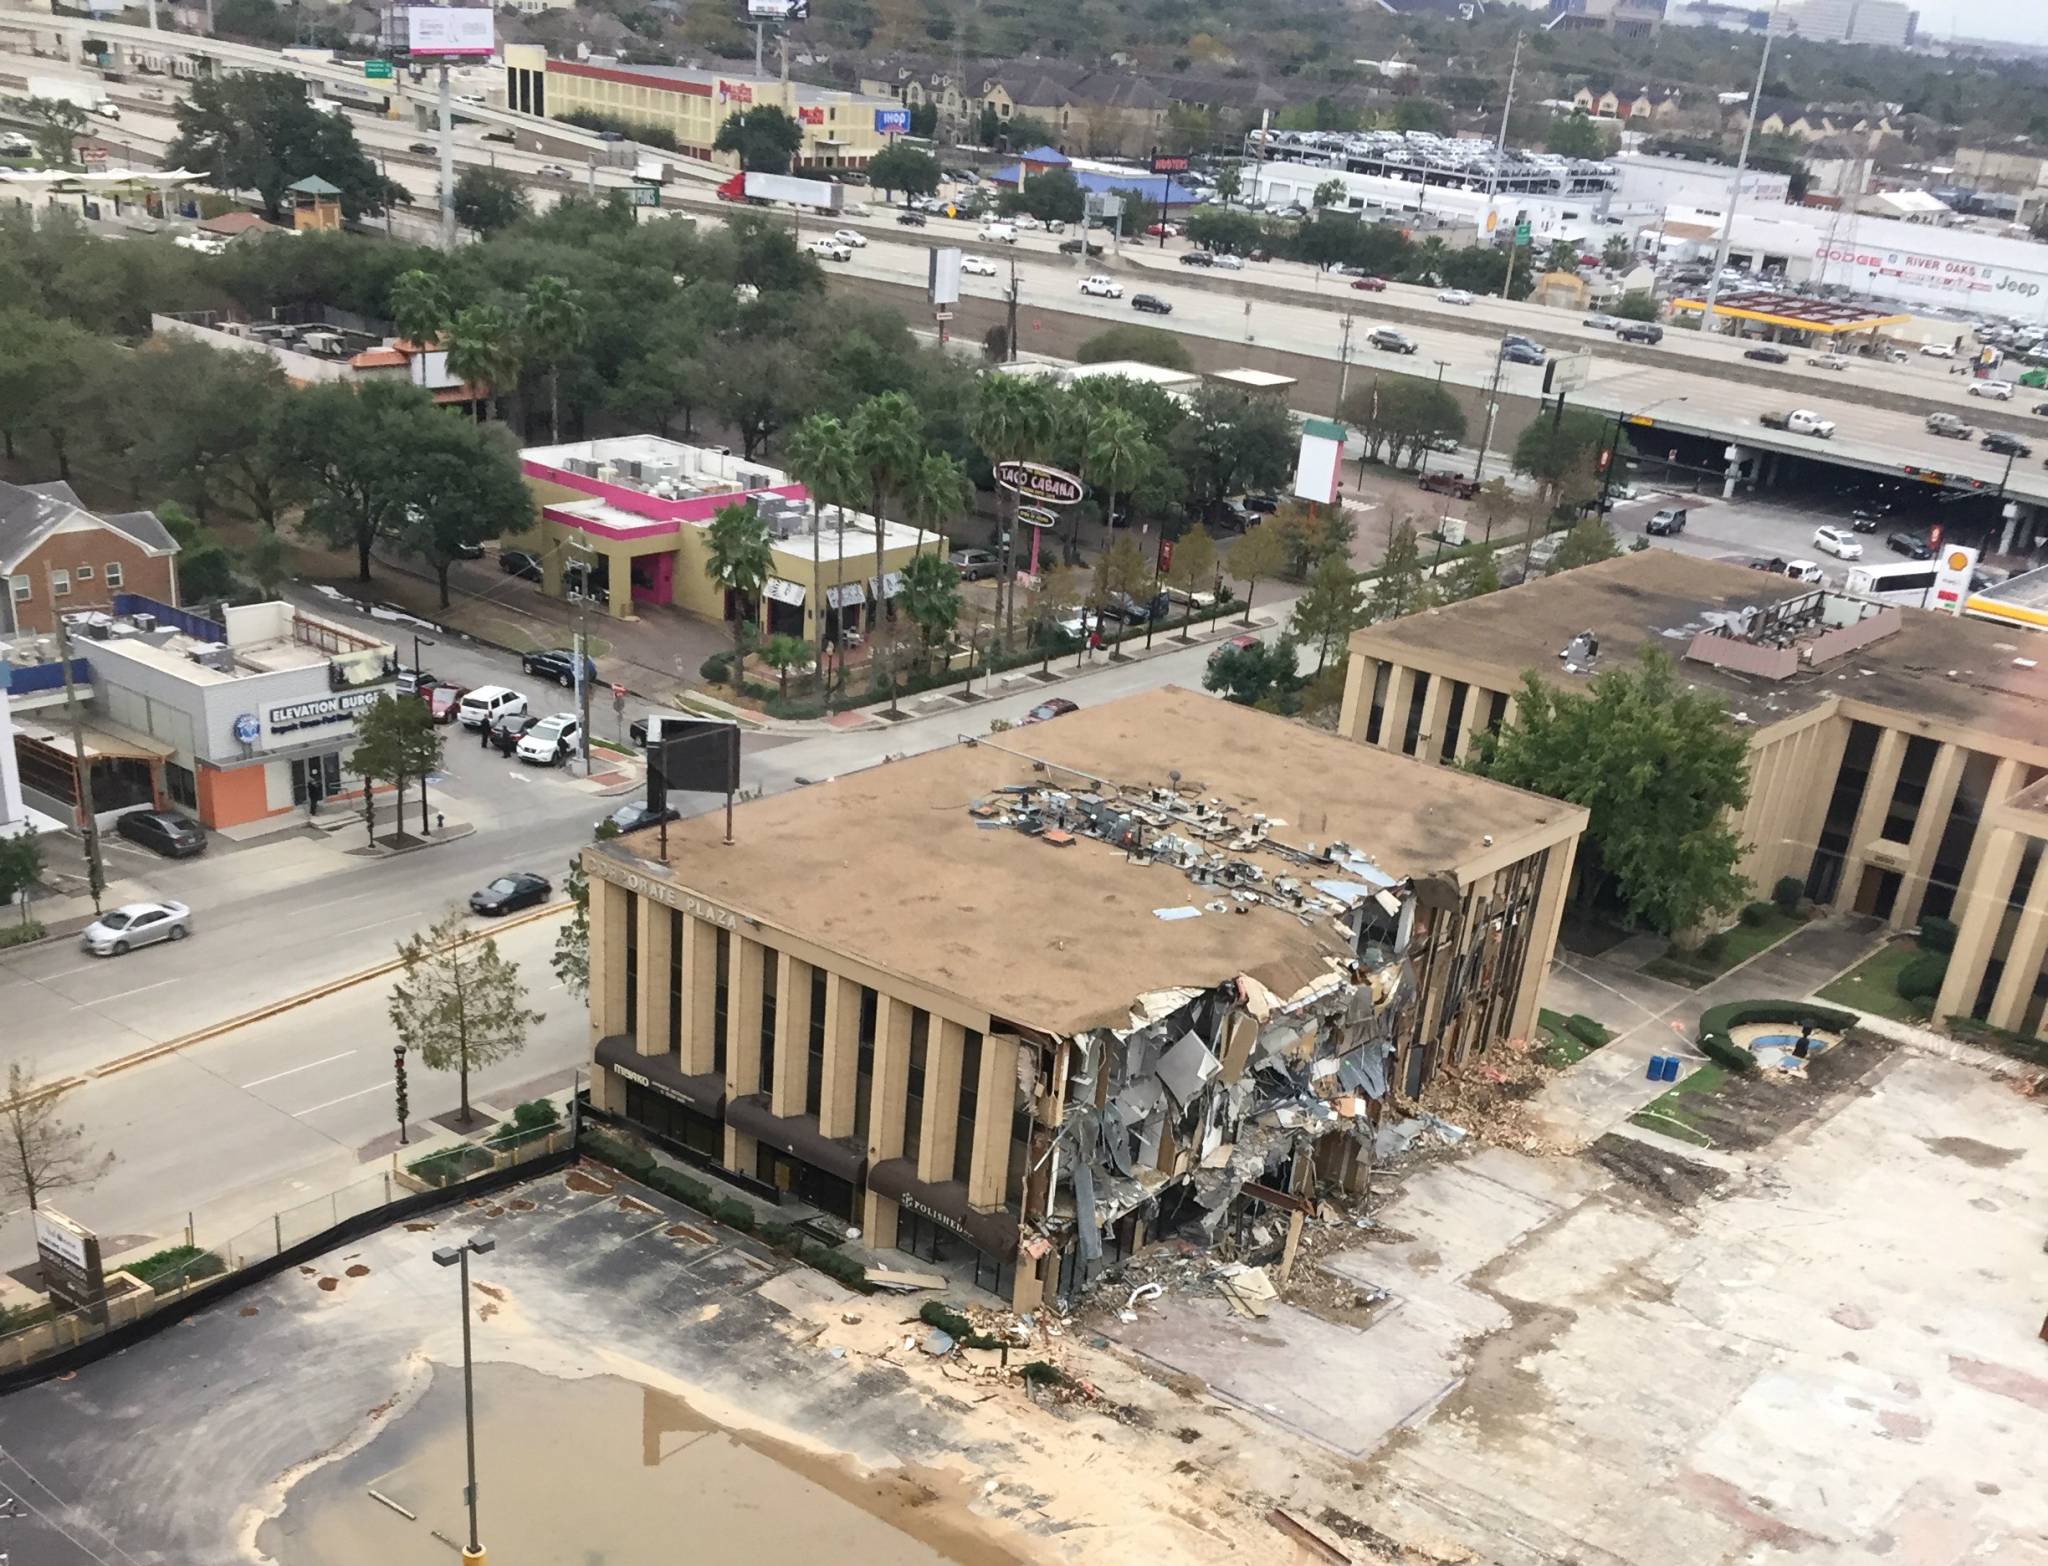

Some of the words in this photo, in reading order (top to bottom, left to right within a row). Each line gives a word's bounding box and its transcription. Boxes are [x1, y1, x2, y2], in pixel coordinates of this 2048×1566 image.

[883, 112, 906, 127] IHOP
[1816, 248, 1882, 267] DODGE
[1905, 256, 1941, 271] RIVER
[1945, 262, 1977, 277] OAKS
[1996, 274, 2040, 298] Jeep
[1001, 467, 1028, 485] TACO
[1031, 475, 1075, 499] CABANA
[271, 698, 337, 722] ELEVATION
[341, 690, 380, 709] BURGE
[588, 856, 677, 905] CORPORATE
[686, 897, 738, 930] PLAZA
[614, 1063, 649, 1087] MIYAKO
[914, 1200, 963, 1233] POLISHED
